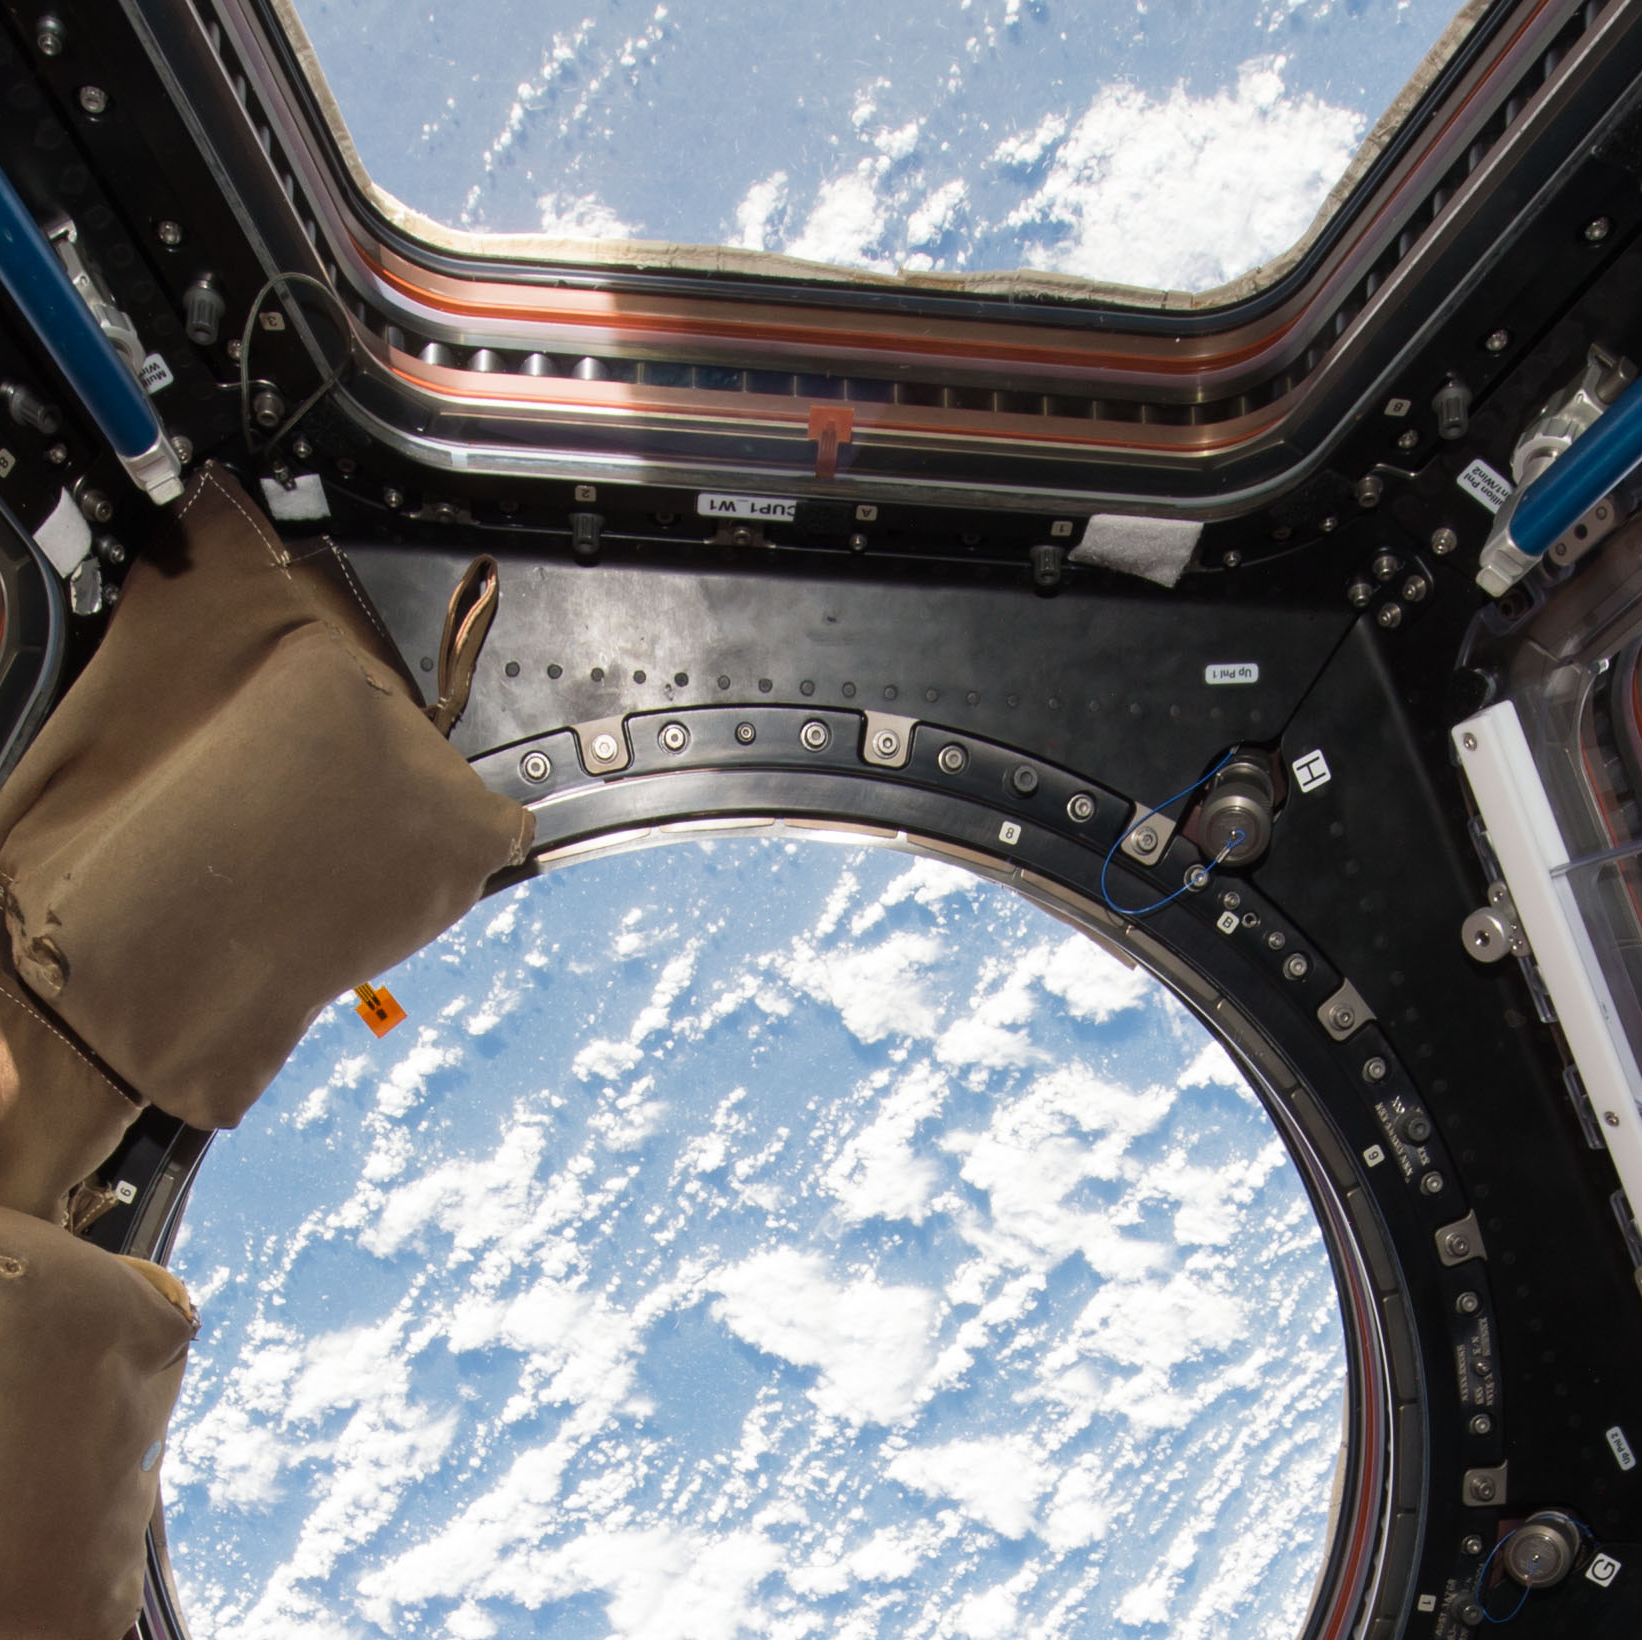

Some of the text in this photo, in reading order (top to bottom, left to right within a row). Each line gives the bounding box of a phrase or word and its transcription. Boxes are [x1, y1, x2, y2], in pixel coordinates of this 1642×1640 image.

[268, 315, 275, 325] 3
[1462, 471, 1481, 488] Pnl
[1470, 464, 1511, 500] in1/Win2
[581, 488, 589, 497] 2
[708, 498, 795, 515] CUP1_W1
[860, 506, 871, 516] A
[1212, 667, 1251, 678] Up Pnl 1
[1295, 756, 1327, 786] H
[1005, 828, 1014, 839] 8
[1222, 916, 1233, 929] B
[1368, 1151, 1379, 1161] 9
[1609, 1431, 1632, 1464] Up Pnl 2
[1592, 1559, 1615, 1581] G
[1422, 1598, 1431, 1606] 1
